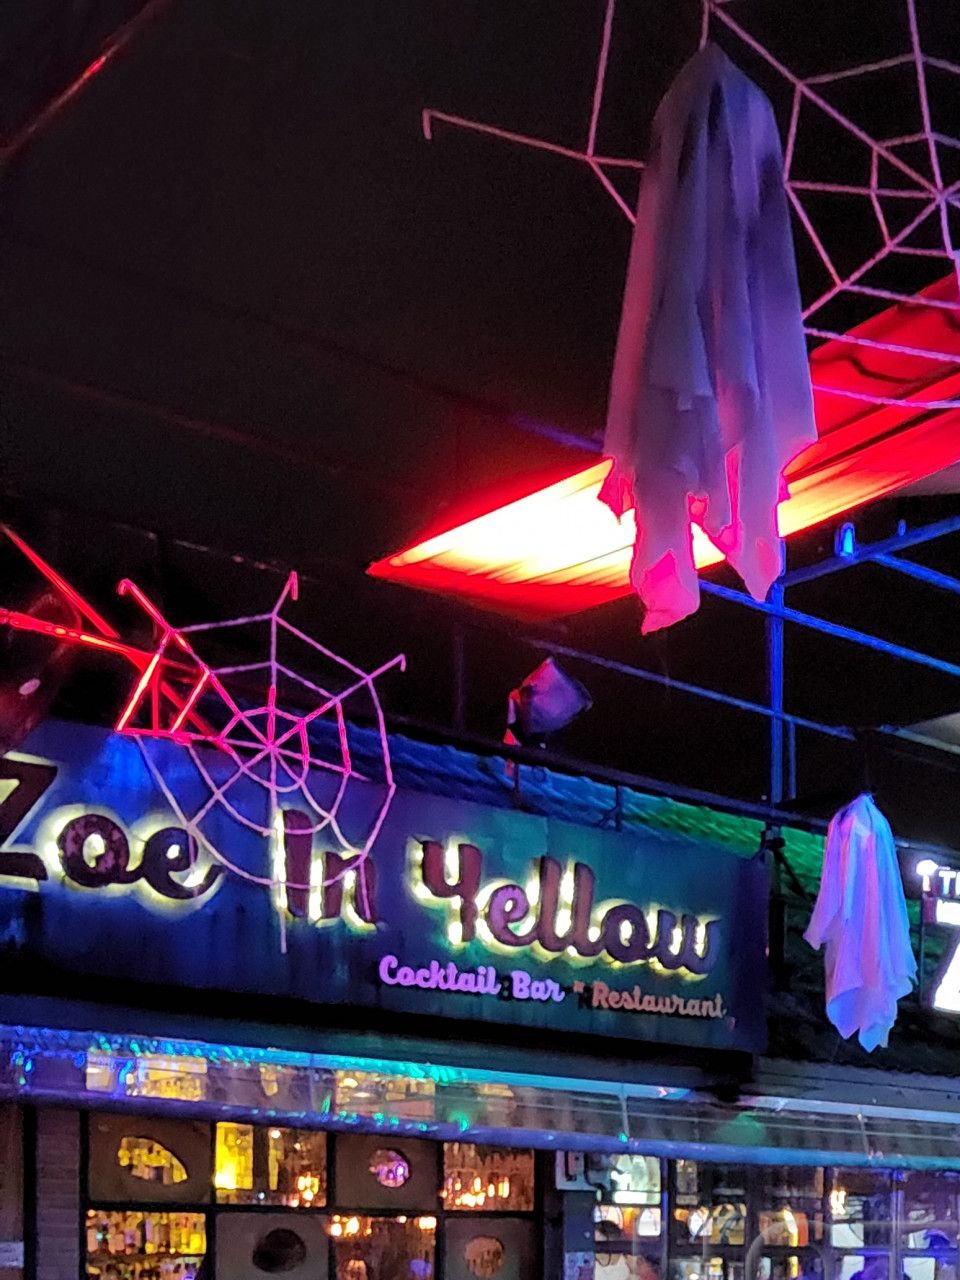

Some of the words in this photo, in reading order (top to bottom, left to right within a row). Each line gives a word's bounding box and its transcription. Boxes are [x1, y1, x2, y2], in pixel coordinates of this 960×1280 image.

[0, 755, 219, 900] Zoe
[281, 808, 378, 926] In
[416, 838, 716, 977] Yellow
[379, 955, 501, 995] Cocktail
[511, 971, 565, 1002] Bar
[592, 981, 726, 1018] Restaurant
